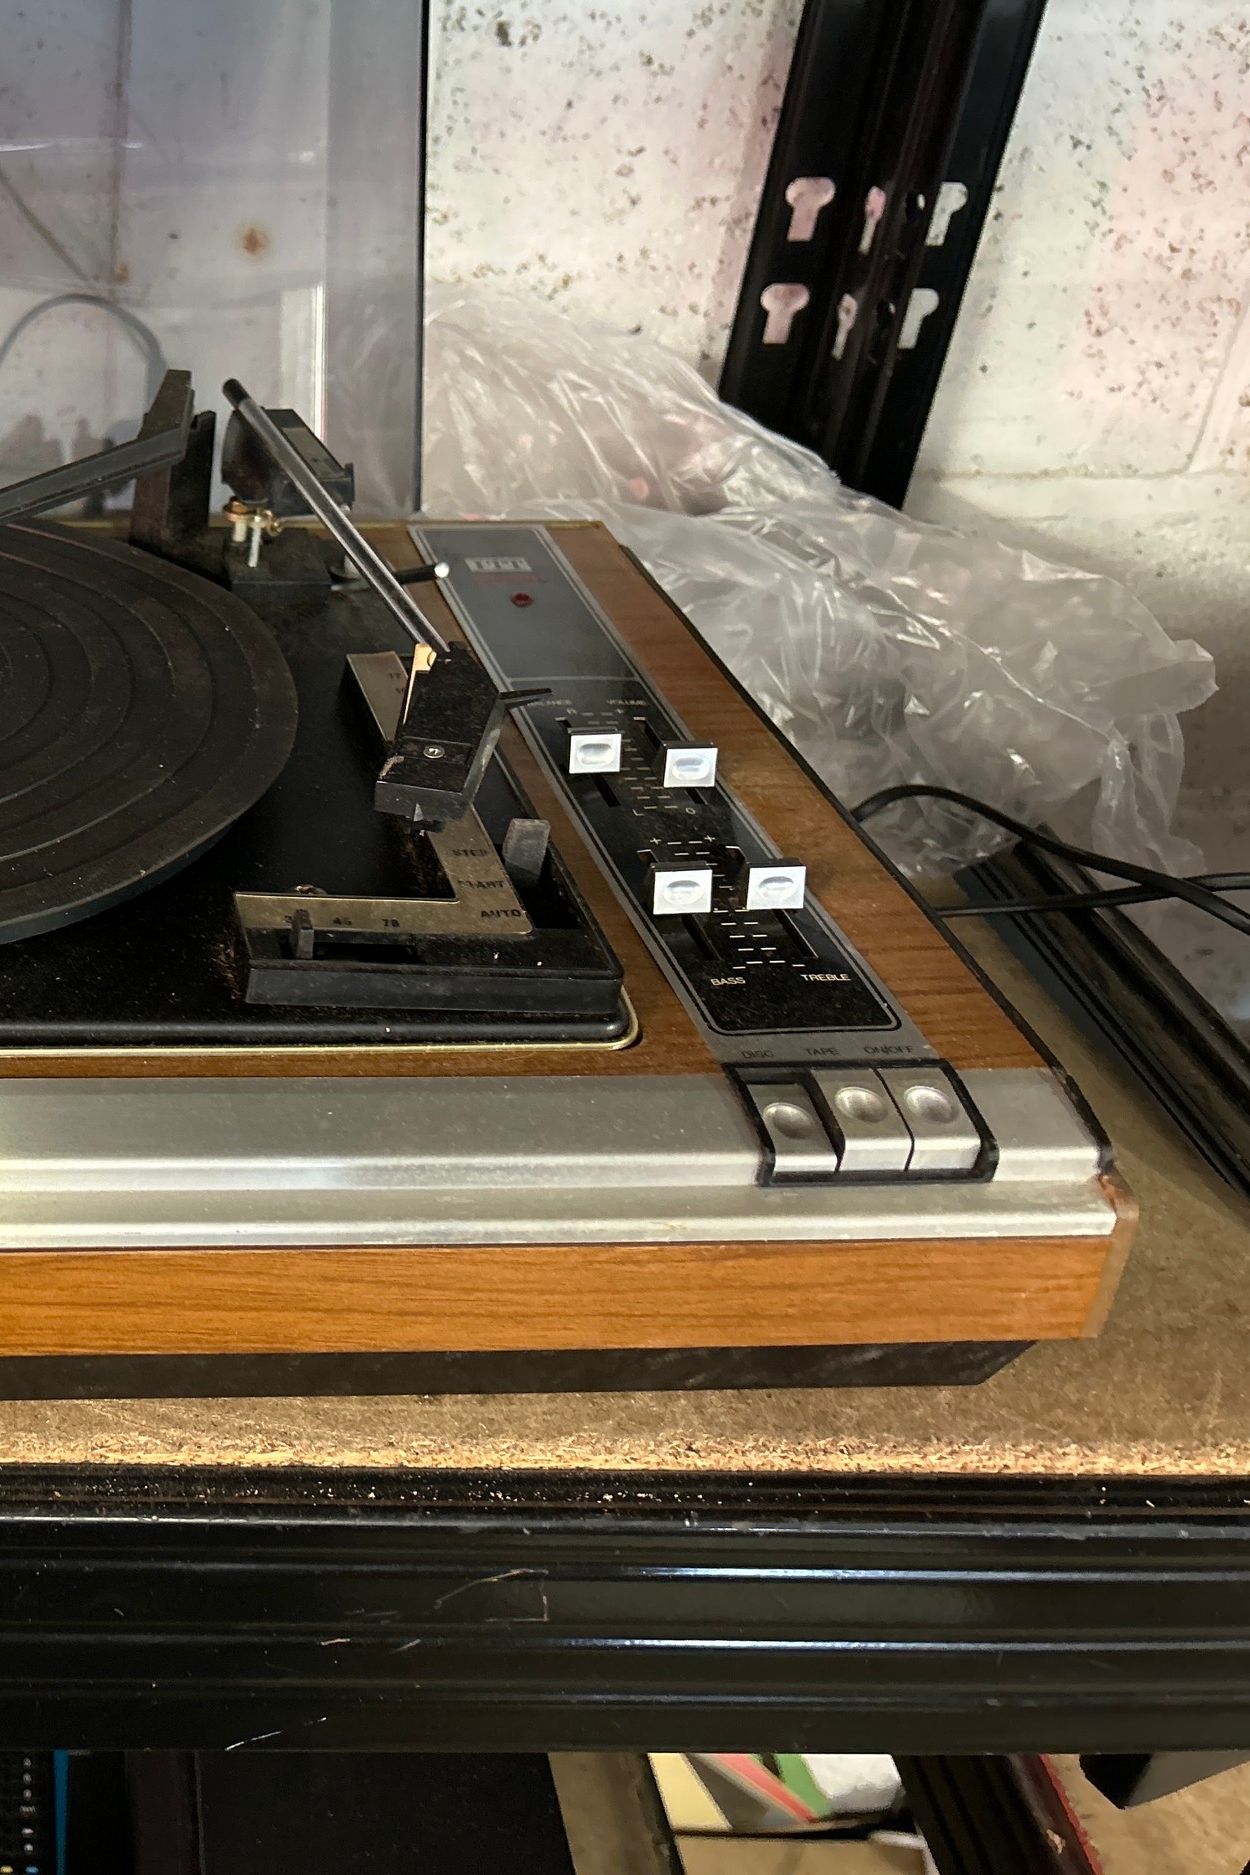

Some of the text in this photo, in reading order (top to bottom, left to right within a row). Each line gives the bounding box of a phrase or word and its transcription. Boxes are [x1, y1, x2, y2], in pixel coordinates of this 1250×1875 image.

[481, 909, 522, 918] AUTO
[382, 918, 400, 928] 78
[710, 973, 851, 986] BASS TREBLE
[741, 1045, 914, 1060] DISC TAPE ON/OFF
